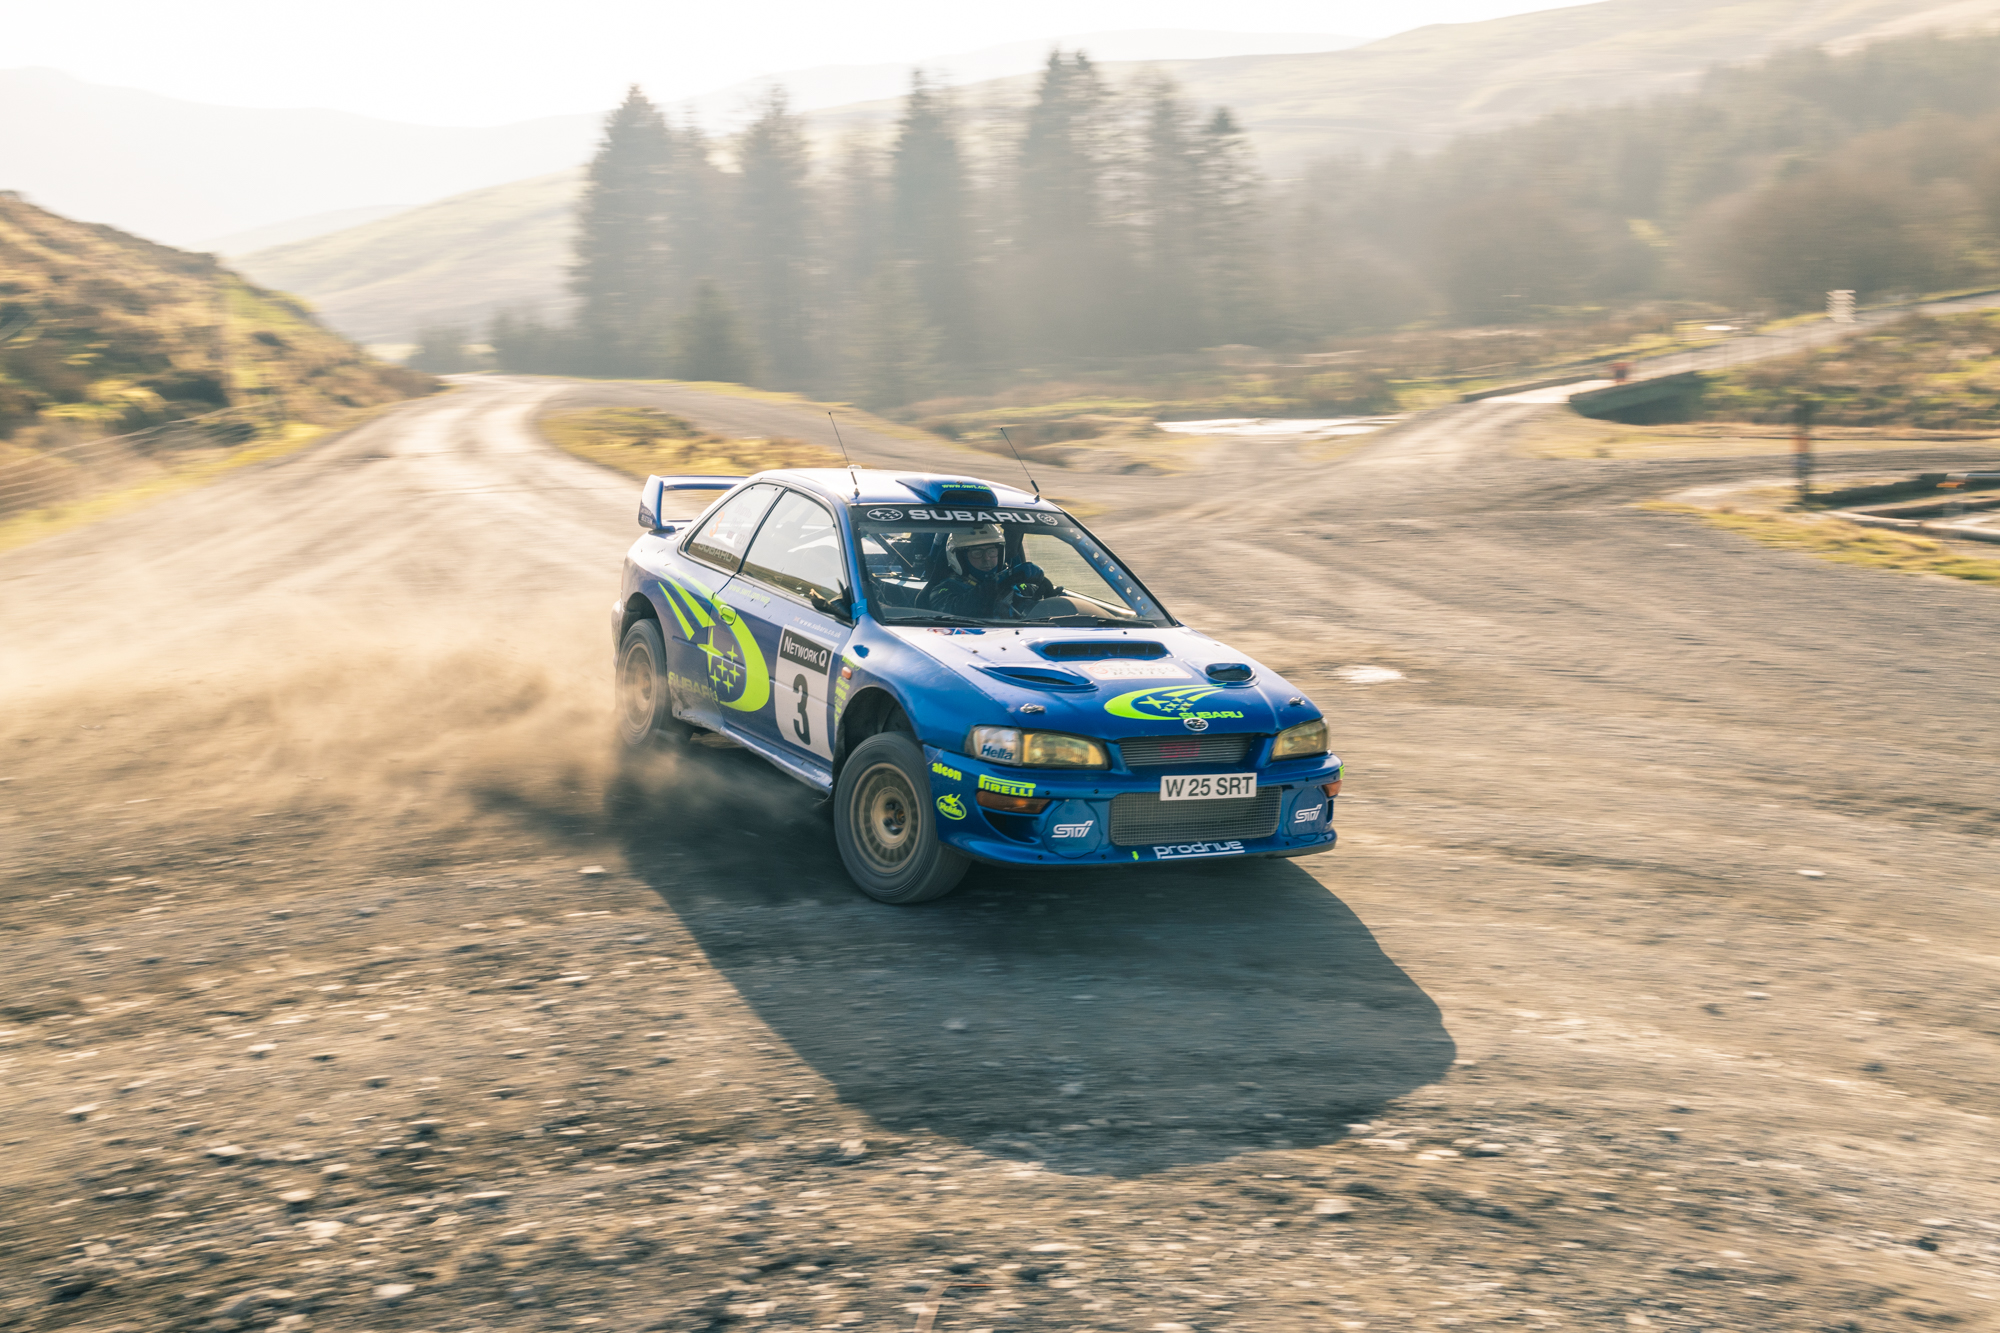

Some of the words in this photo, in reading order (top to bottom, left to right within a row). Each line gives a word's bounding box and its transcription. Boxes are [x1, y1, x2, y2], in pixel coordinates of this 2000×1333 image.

[708, 511, 725, 538] 3
[908, 509, 1036, 524] SUBARU
[783, 635, 819, 664] NETWORK
[818, 650, 828, 668] Q
[793, 673, 811, 746] 3
[1178, 710, 1244, 719] SUBARU
[980, 744, 1014, 761] Hella
[932, 762, 962, 781] alcon
[978, 773, 1036, 798] PIRELLI
[1165, 778, 1185, 797] W
[1188, 777, 1212, 796] 25
[1215, 775, 1254, 796] SRT
[1152, 840, 1245, 859] prodrive
